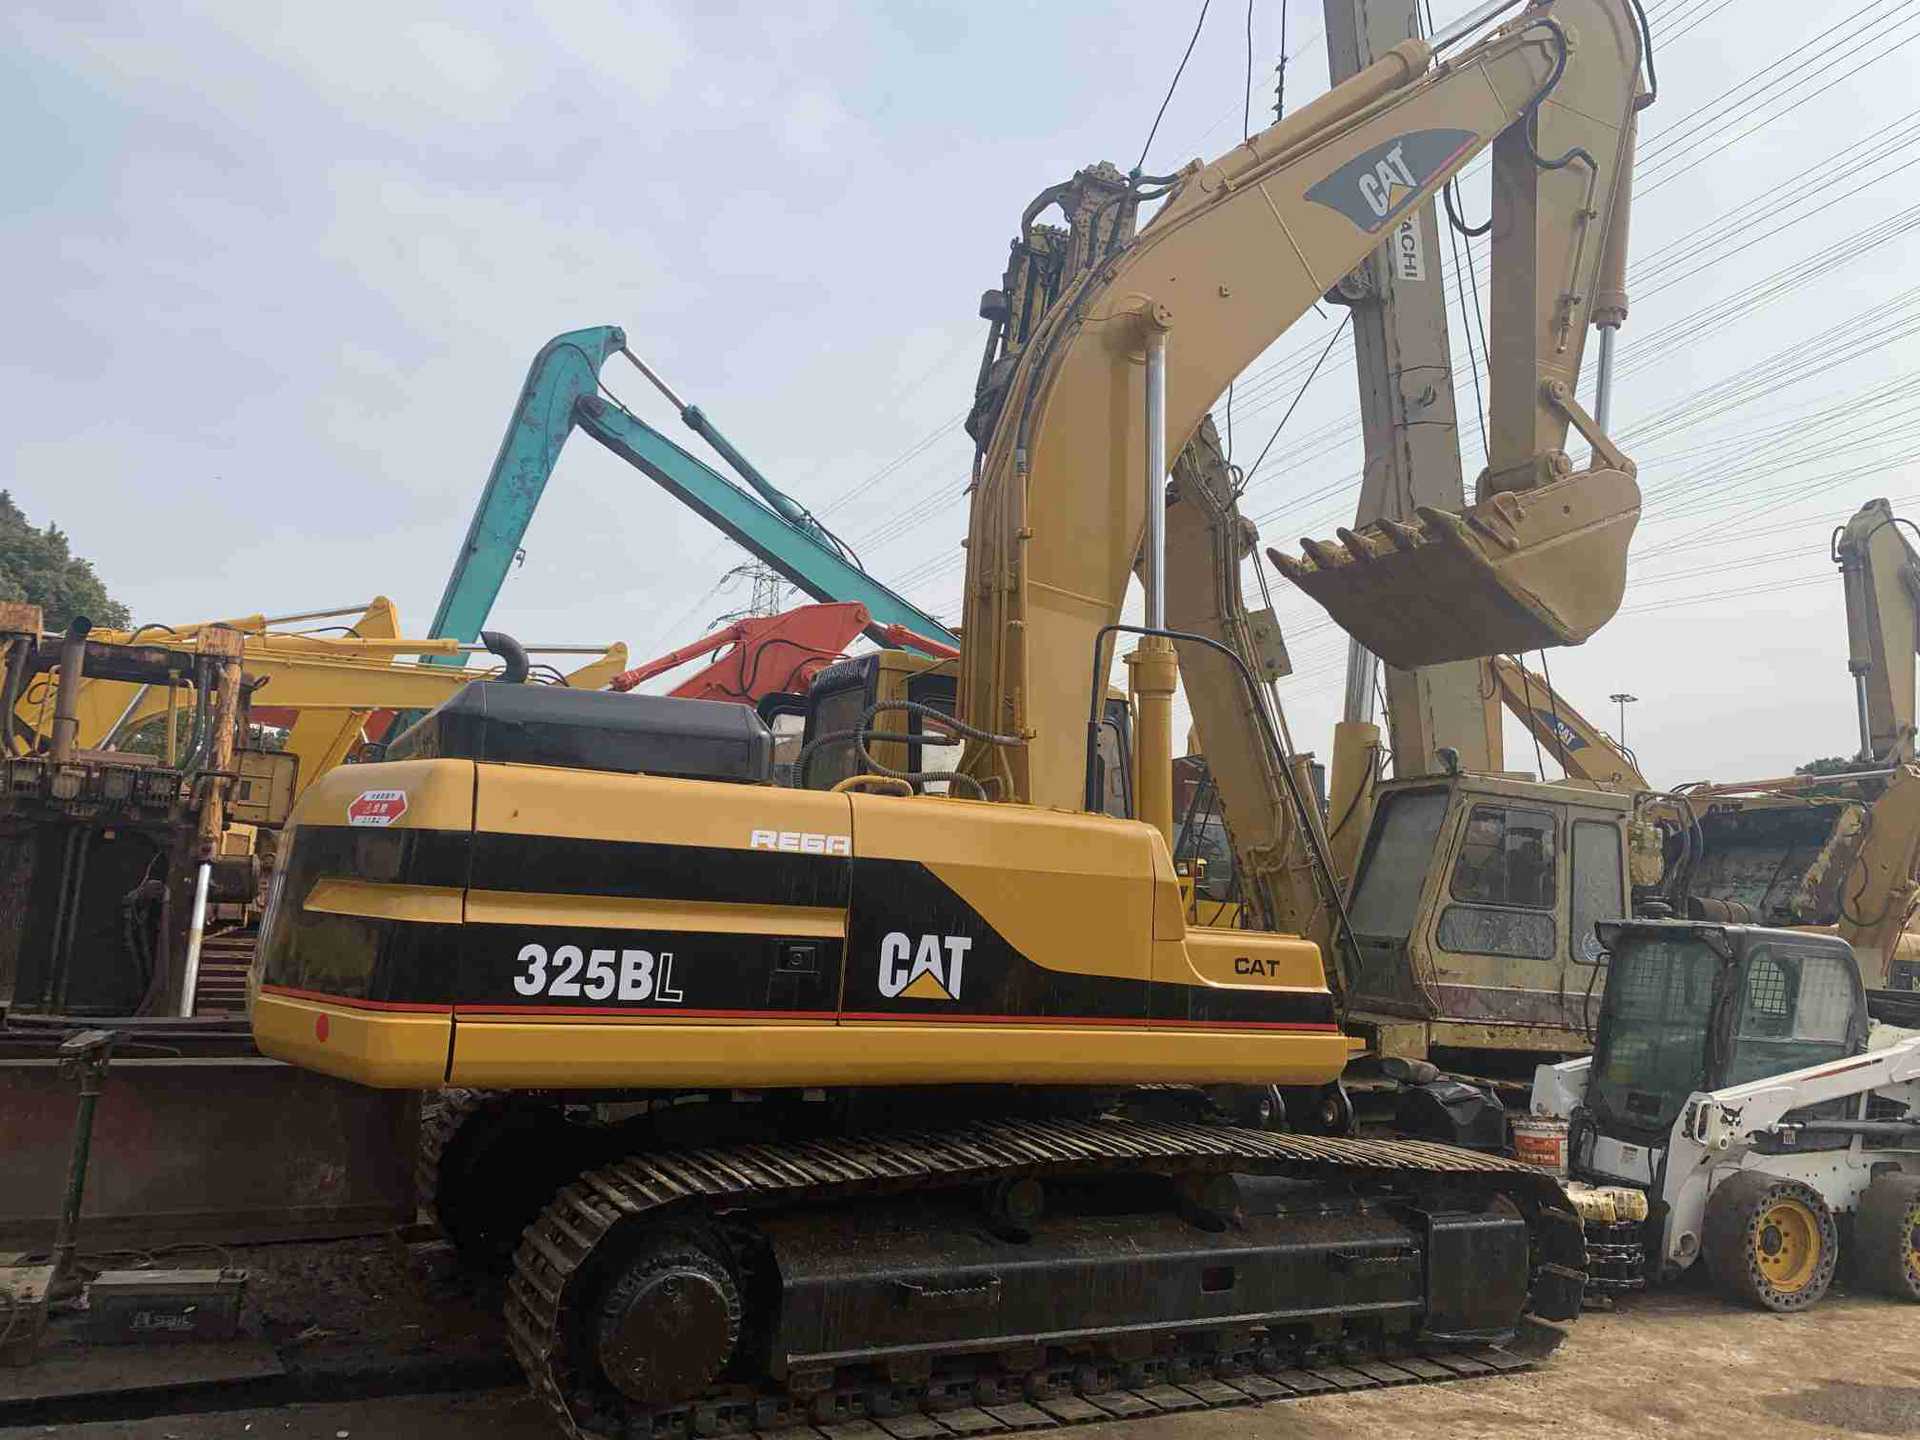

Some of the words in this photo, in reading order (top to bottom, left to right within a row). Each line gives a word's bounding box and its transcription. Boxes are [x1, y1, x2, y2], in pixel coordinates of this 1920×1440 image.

[1359, 140, 1417, 217] CAT
[1400, 216, 1417, 277] ACHI
[878, 931, 972, 1001] CAT
[1234, 957, 1280, 977] CAT
